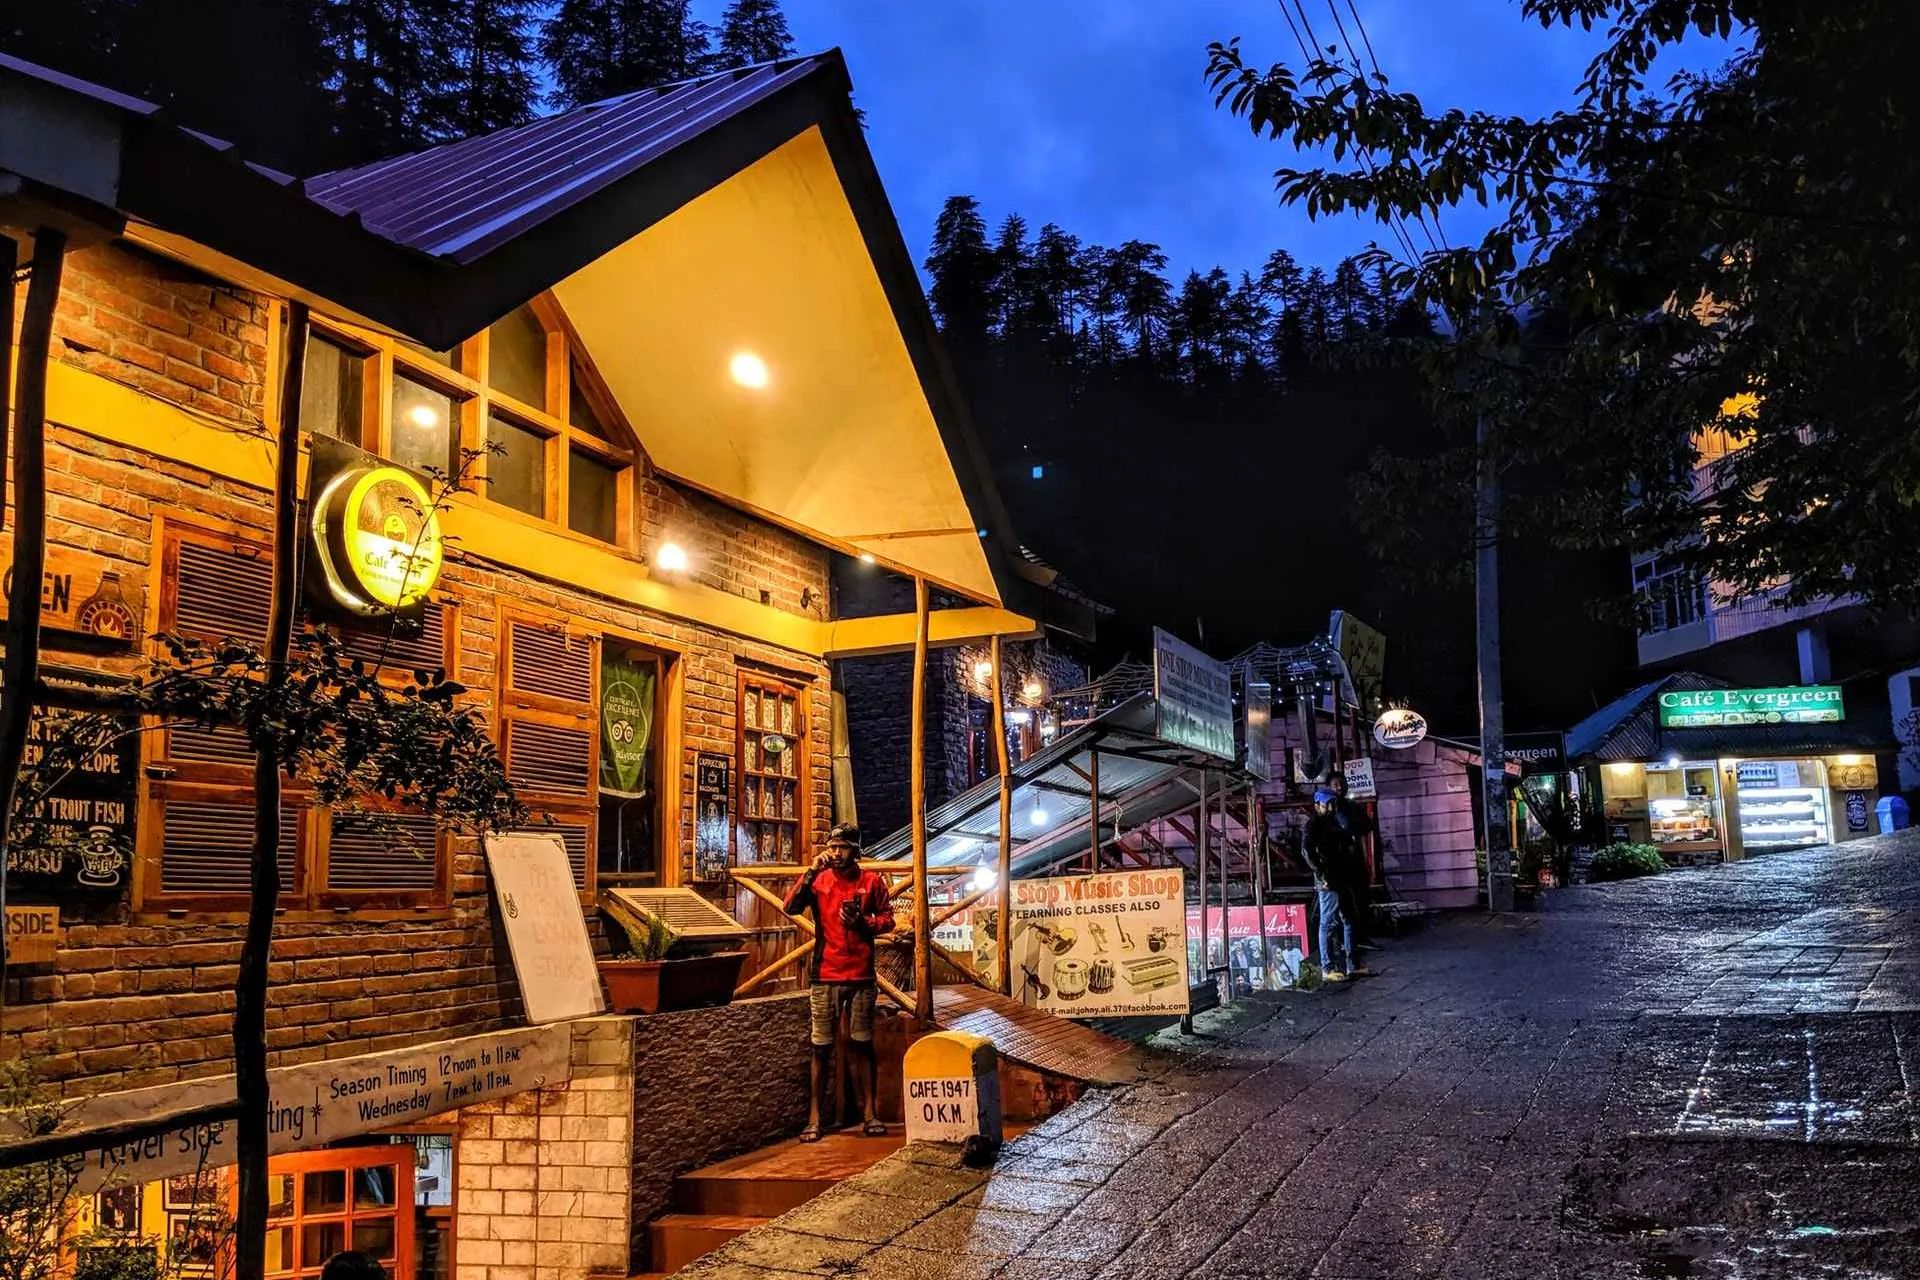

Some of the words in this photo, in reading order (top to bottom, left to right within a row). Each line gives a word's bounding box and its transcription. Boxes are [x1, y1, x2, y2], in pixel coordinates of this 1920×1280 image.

[1660, 691, 1715, 708] Café
[1722, 689, 1841, 708] Evergreen
[49, 797, 91, 822] TROUT
[95, 801, 125, 825] FISH
[1017, 883, 1060, 907] Stop
[1064, 876, 1123, 901] Music
[1128, 873, 1180, 900] Shop
[1016, 907, 1072, 919] LEARNING
[1075, 903, 1126, 915] CLASSES
[1130, 901, 1160, 912] ALSO
[330, 1075, 381, 1099] Season
[386, 1065, 427, 1087] Timing
[481, 1049, 491, 1065] to
[358, 1089, 433, 1122] Wednesday
[472, 1075, 483, 1093] to
[909, 1080, 939, 1098] CAFE
[941, 1080, 970, 1098] 1947
